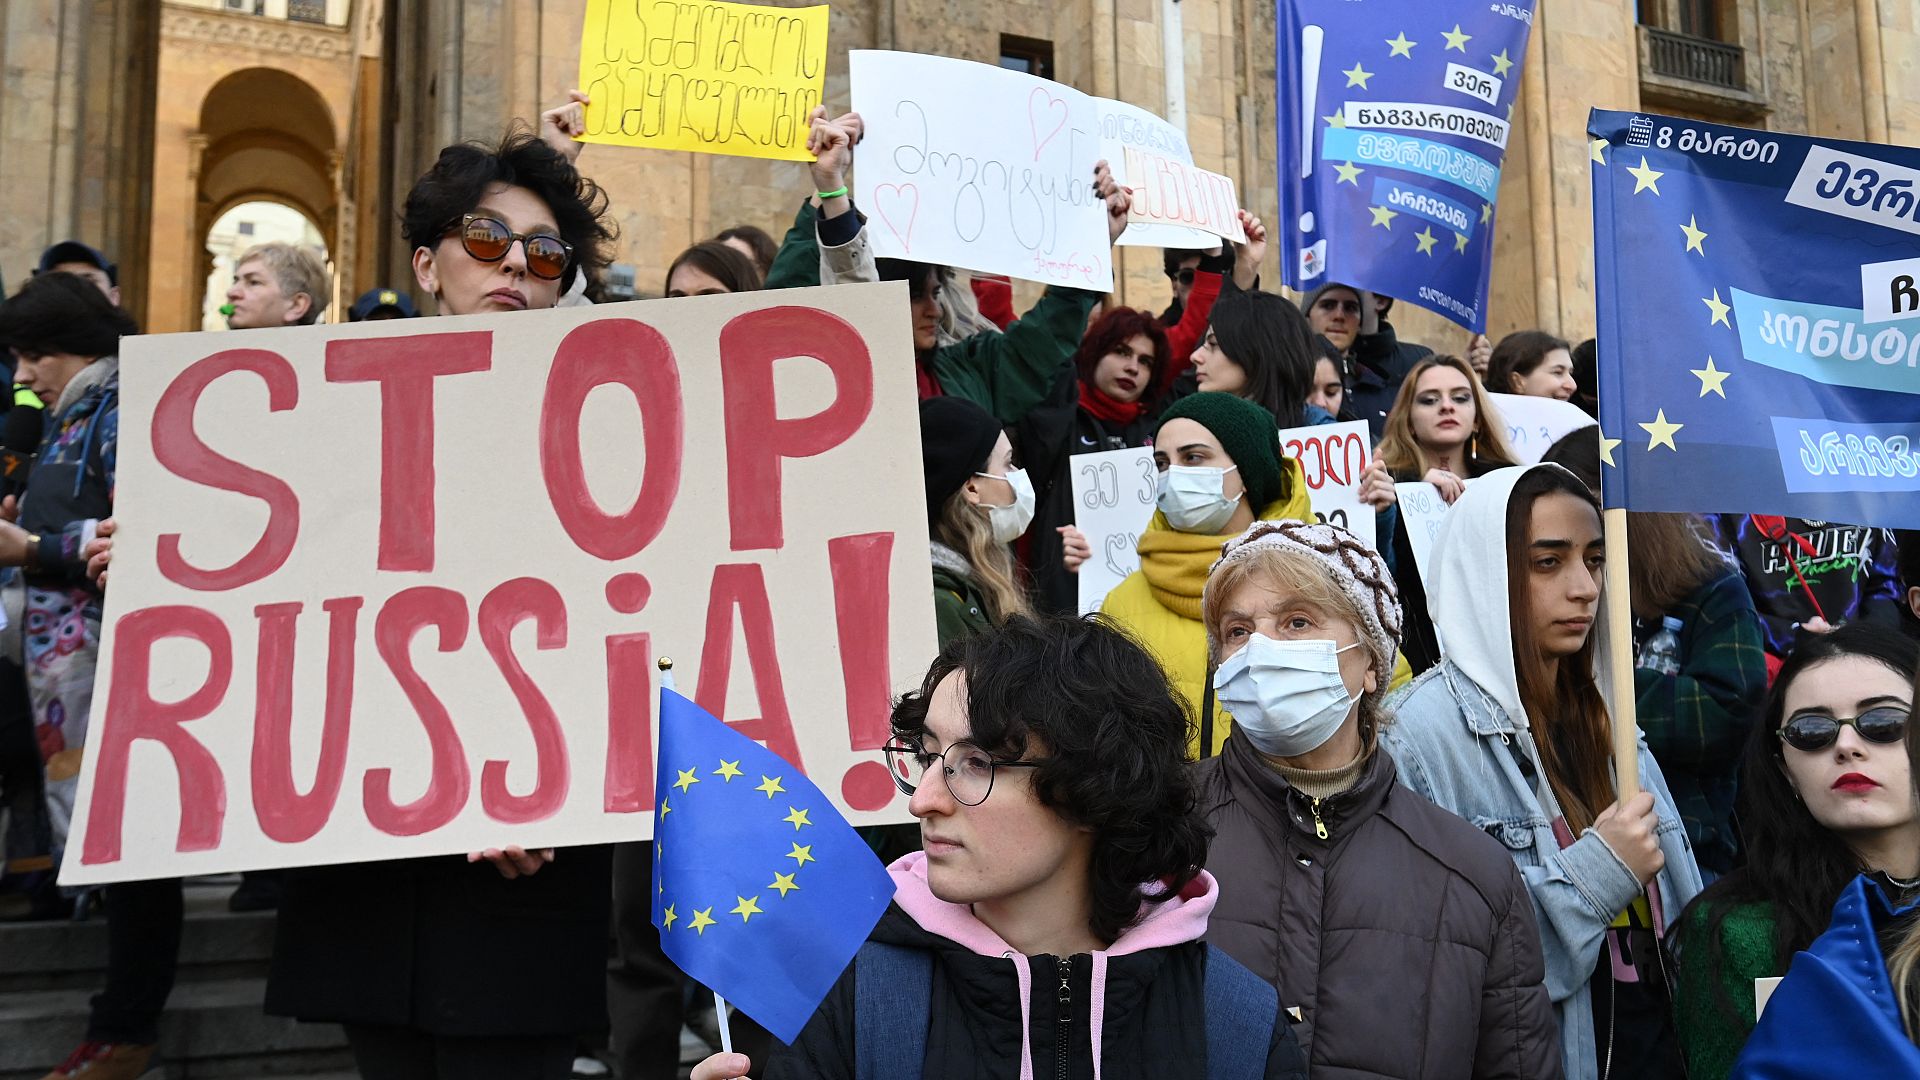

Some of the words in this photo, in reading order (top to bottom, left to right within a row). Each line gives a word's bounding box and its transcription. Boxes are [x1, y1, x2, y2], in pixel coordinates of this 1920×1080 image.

[1453, 70, 1493, 99] ვერ
[1656, 126, 1673, 150] 8
[1678, 128, 1780, 164] მარტი
[1387, 186, 1468, 231] არჩევანს
[1815, 160, 1920, 223] ევრ
[151, 305, 874, 592] STOP
[1081, 461, 1120, 510] მე
[1280, 432, 1366, 489] ველი
[1799, 429, 1920, 478] არჩევ
